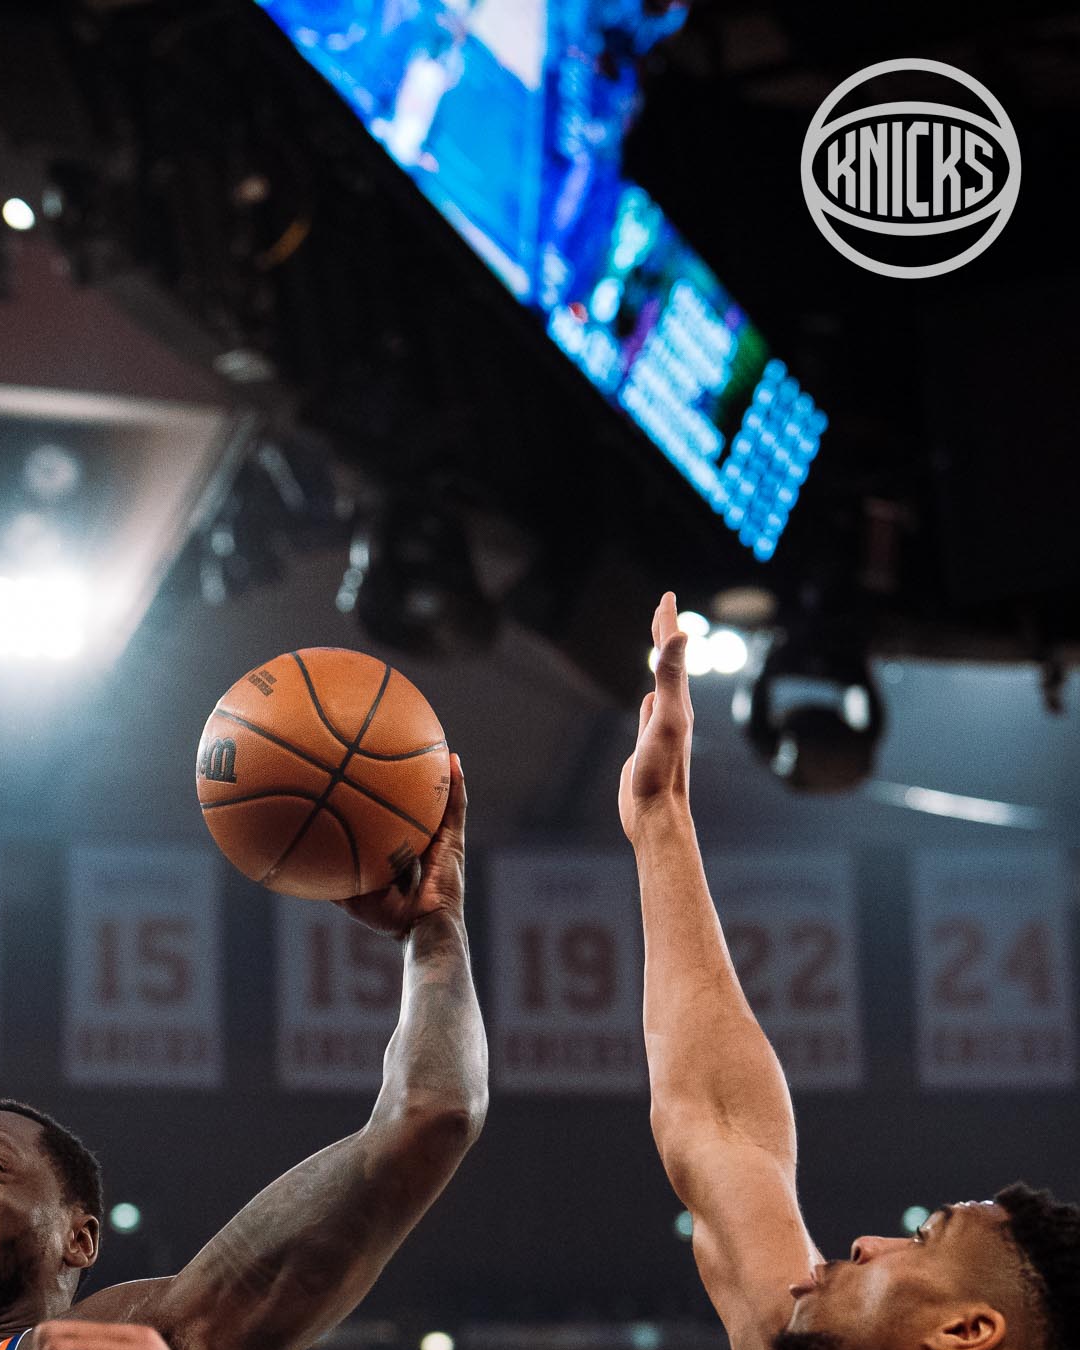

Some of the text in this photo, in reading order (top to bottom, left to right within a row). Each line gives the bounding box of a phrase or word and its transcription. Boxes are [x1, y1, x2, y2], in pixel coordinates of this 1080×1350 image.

[93, 914, 199, 1006] 15
[517, 921, 619, 1015] 19
[930, 911, 1058, 1010] 24
